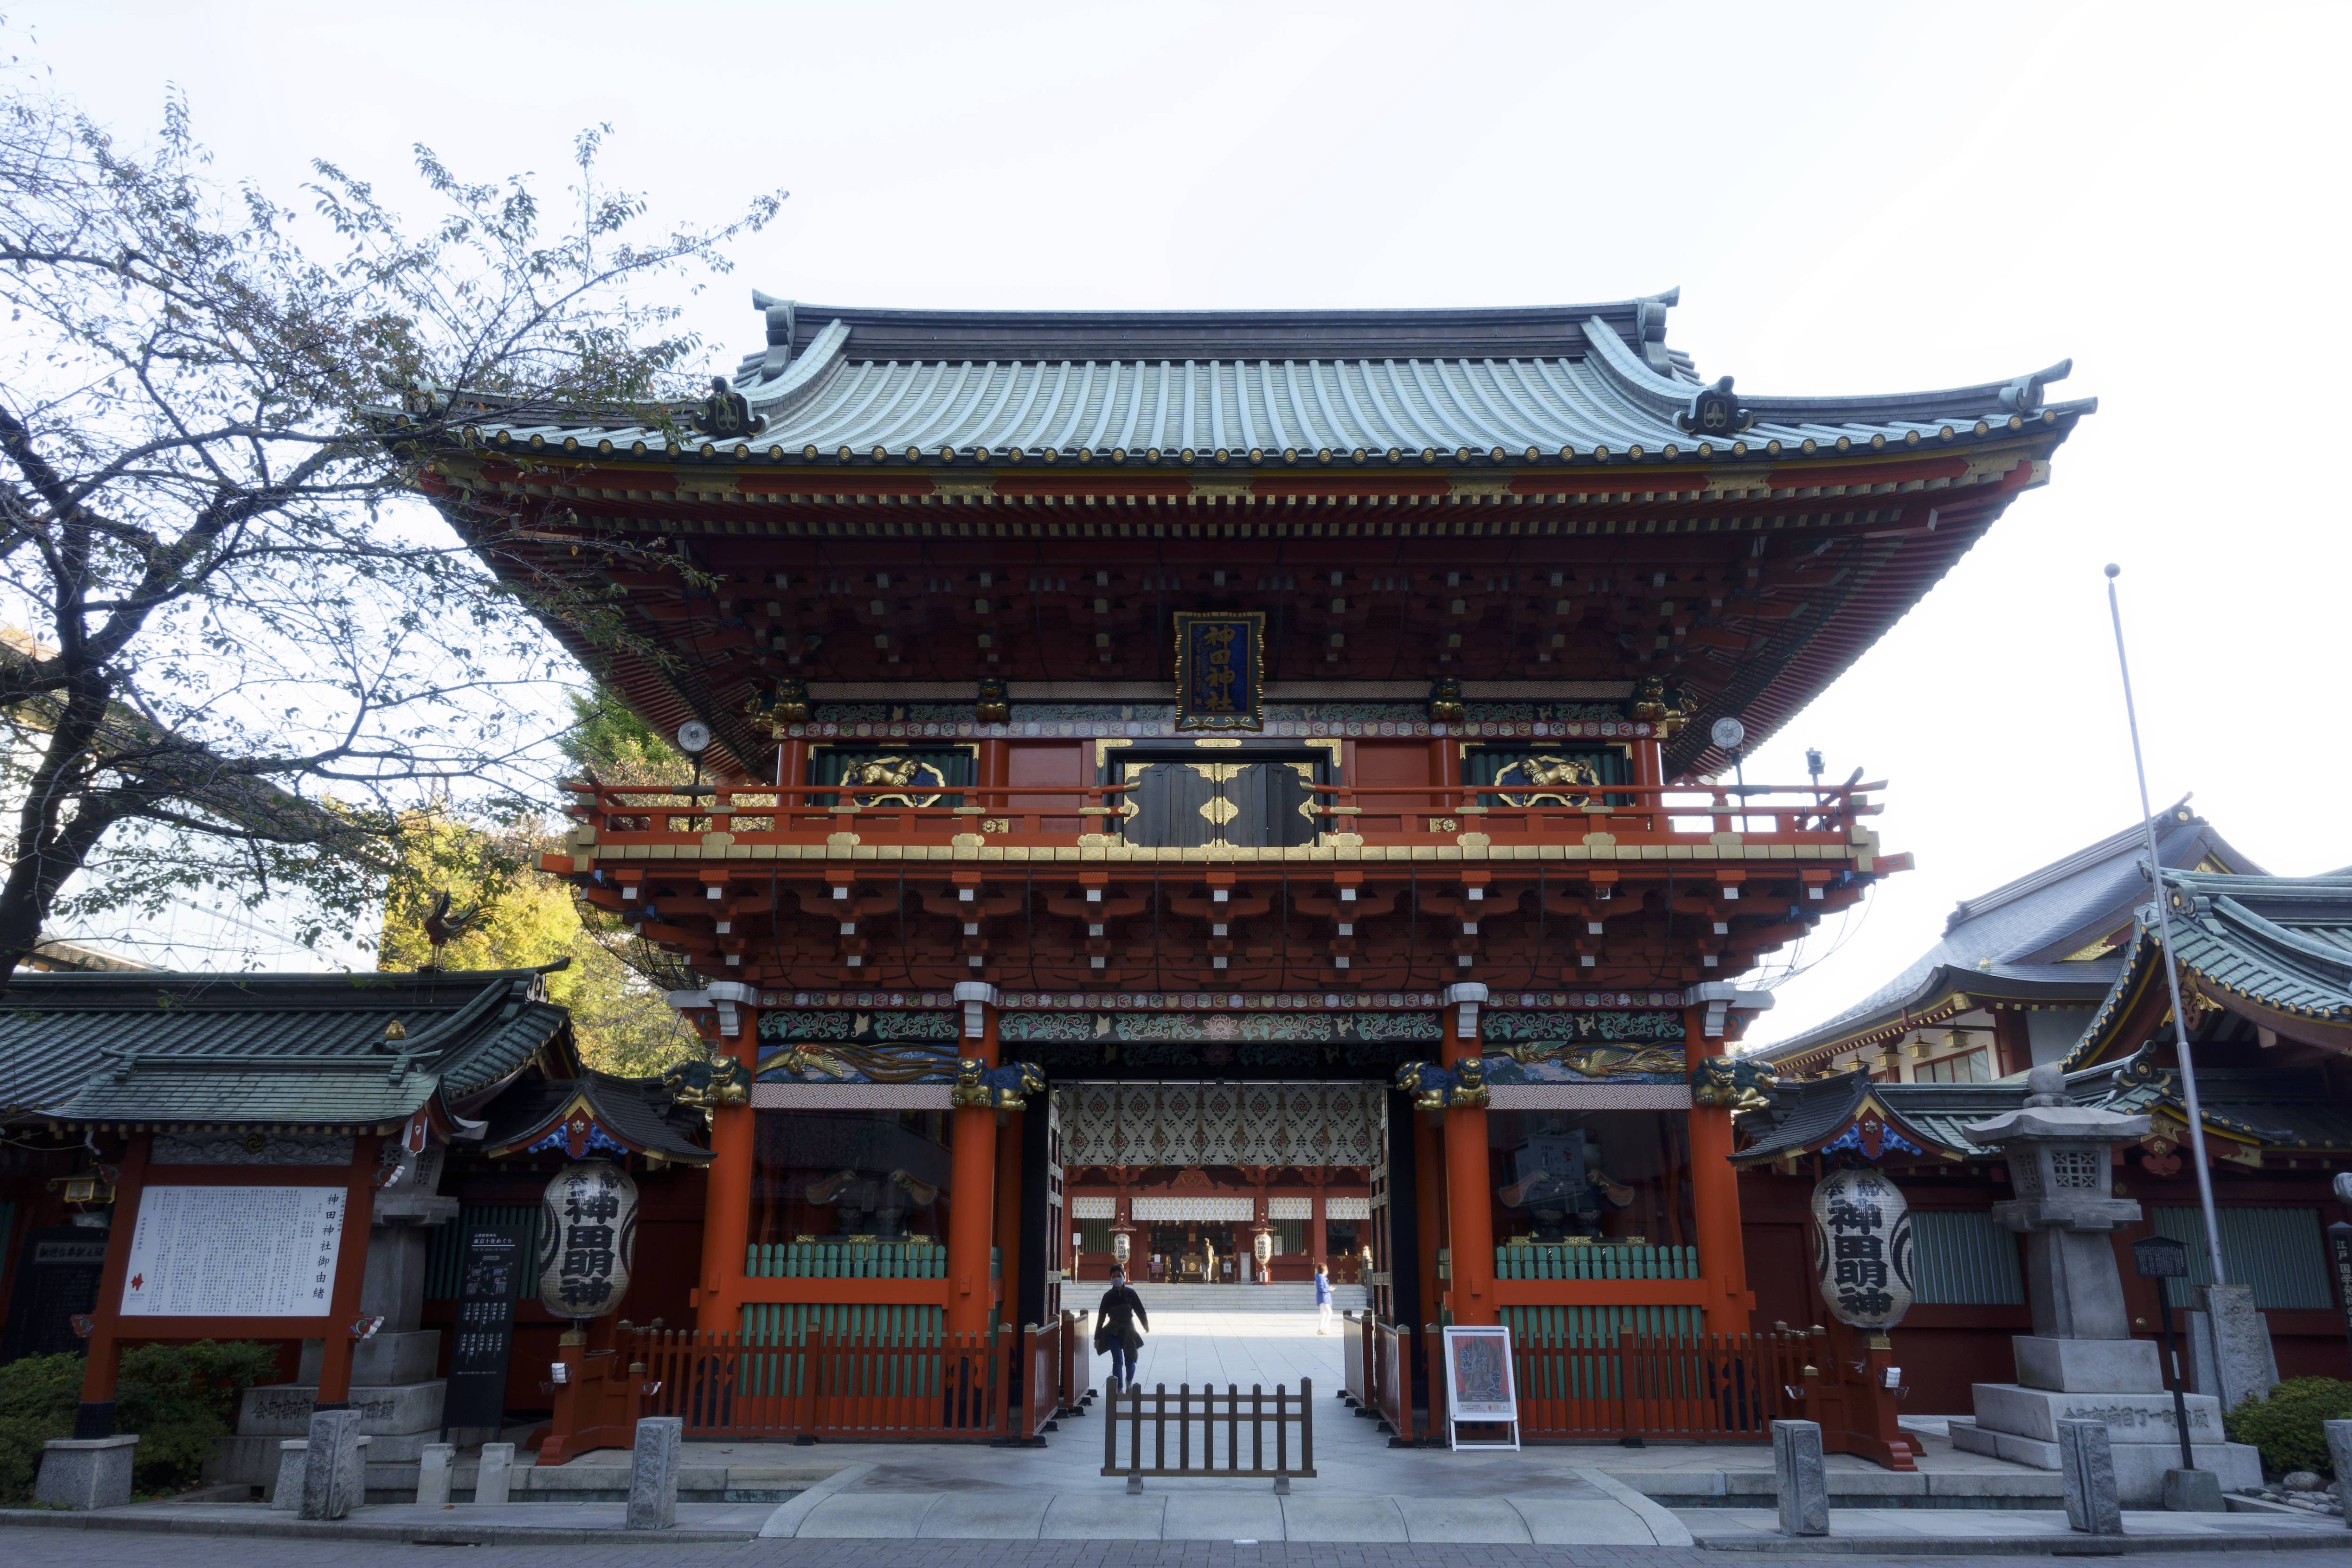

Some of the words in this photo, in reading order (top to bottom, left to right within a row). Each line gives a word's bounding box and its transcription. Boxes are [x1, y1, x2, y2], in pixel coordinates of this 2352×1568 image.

[1203, 624, 1236, 711] 神田神社
[312, 1194, 339, 1299] 神田神社御由緒
[559, 1189, 620, 1307] 神田明神
[1827, 1198, 1893, 1316] 神田明神
[2336, 1241, 2348, 1260] 江戸
